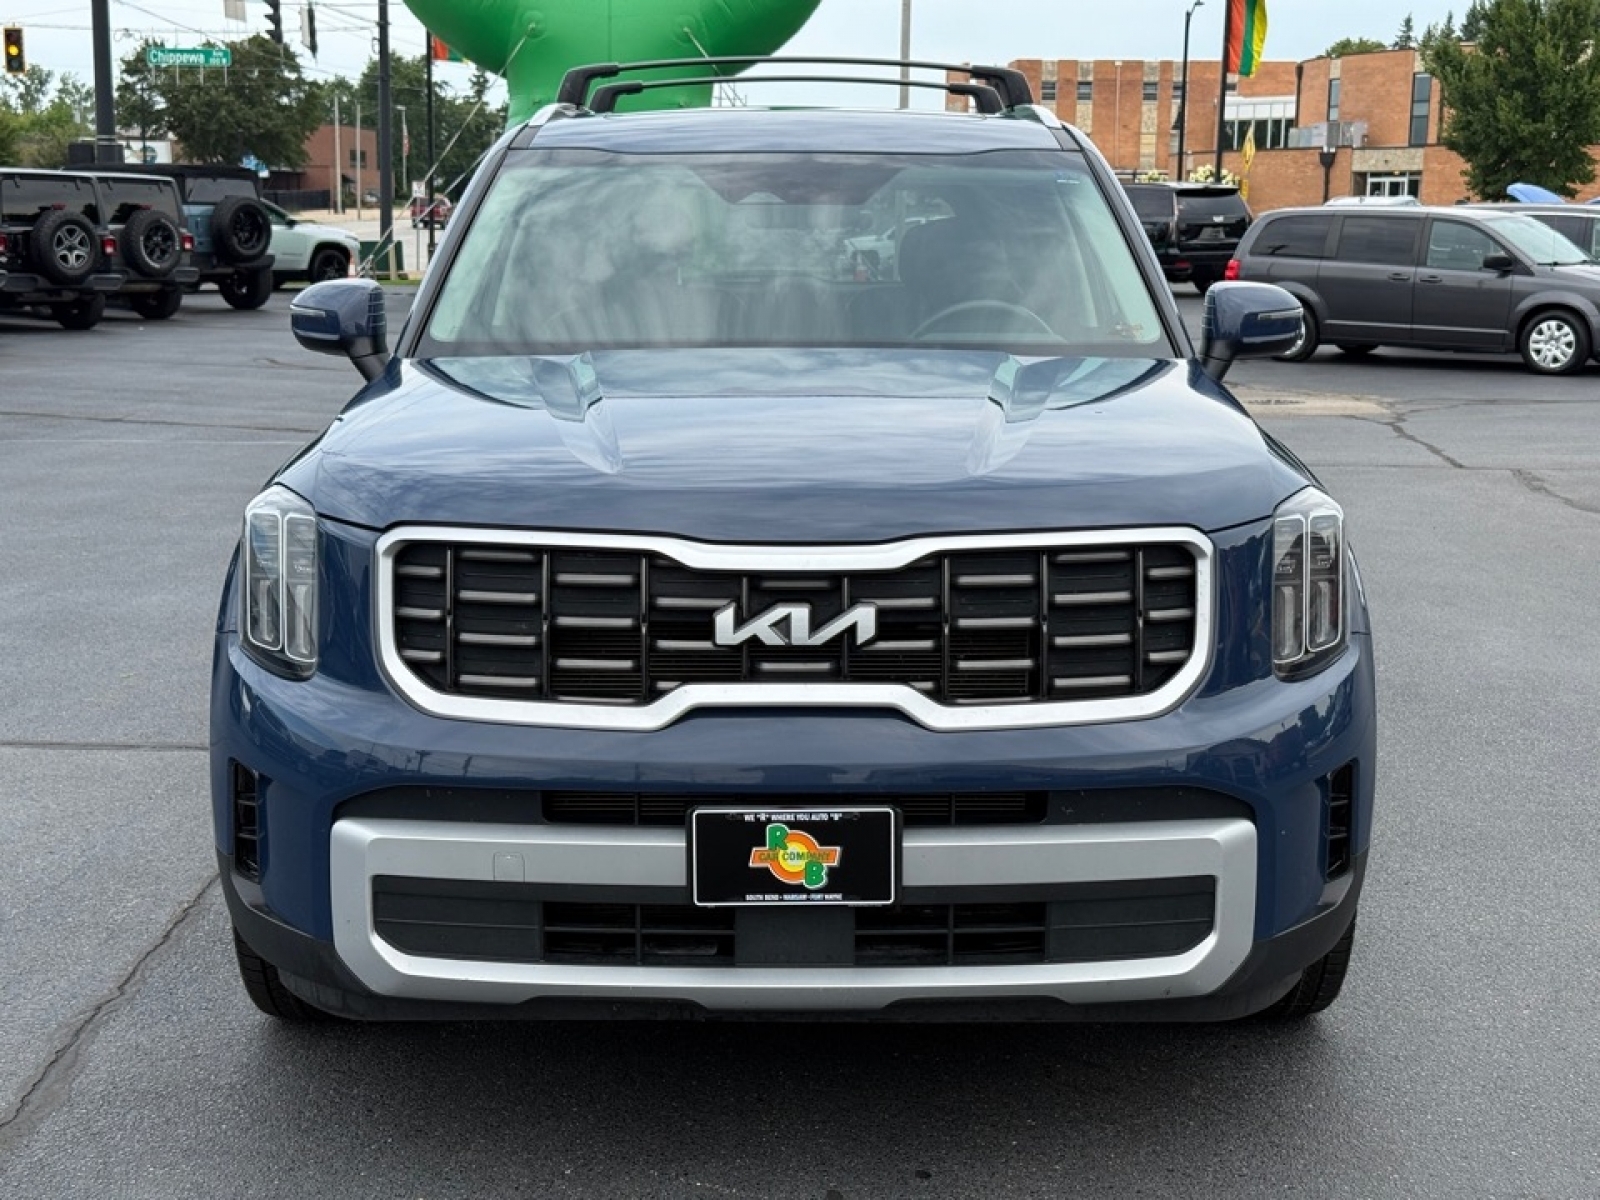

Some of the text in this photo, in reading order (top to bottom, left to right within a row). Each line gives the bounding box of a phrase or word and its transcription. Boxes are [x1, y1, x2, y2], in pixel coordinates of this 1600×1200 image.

[149, 49, 205, 64] Chippewa
[714, 602, 876, 645] KIA
[744, 814, 755, 822] WE
[767, 823, 789, 850] R
[759, 851, 830, 861] CAR COMPANY
[804, 861, 826, 888] B
